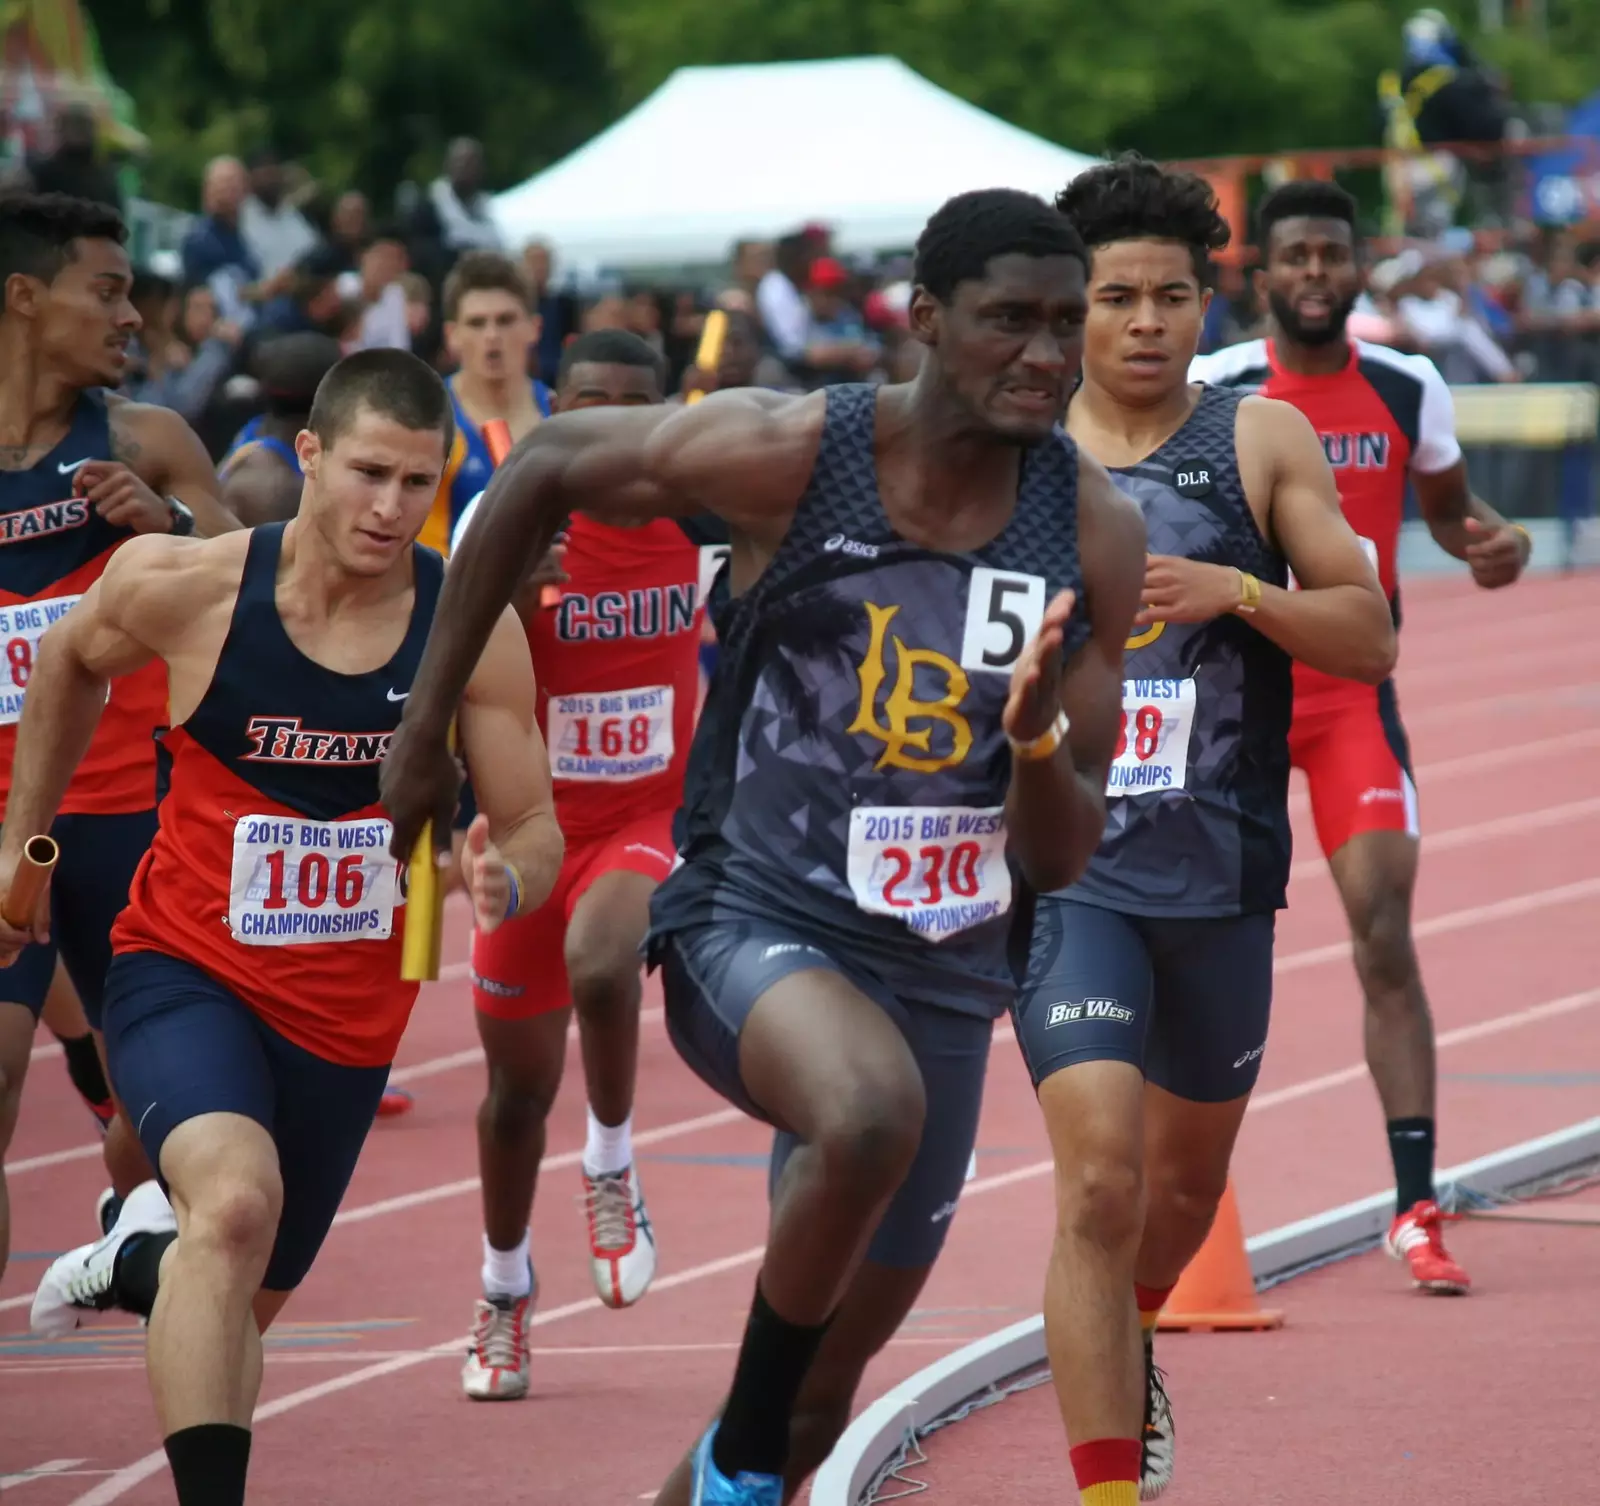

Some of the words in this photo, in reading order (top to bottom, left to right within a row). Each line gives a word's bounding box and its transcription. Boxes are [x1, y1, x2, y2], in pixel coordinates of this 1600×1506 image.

[1176, 470, 1210, 487] DLR
[14, 608, 42, 630] BIG
[44, 602, 77, 625] WE
[556, 584, 699, 641] CSUN
[981, 577, 1030, 667] 5
[558, 699, 594, 714] 2015
[599, 697, 622, 713] BIG
[627, 690, 664, 710] WEST
[1134, 679, 1182, 699] WEST
[574, 713, 651, 757] 168
[247, 822, 293, 844] 2015
[300, 826, 331, 847] BIG
[338, 825, 384, 848] WEST
[864, 816, 914, 841] 2015
[920, 815, 952, 840] BIG
[263, 850, 365, 909] 106
[881, 840, 981, 907] 230
[241, 910, 379, 935] CHAMPIONSHIPS
[1049, 1004, 1081, 1024] BIG
[1086, 1000, 1132, 1020] WEST
